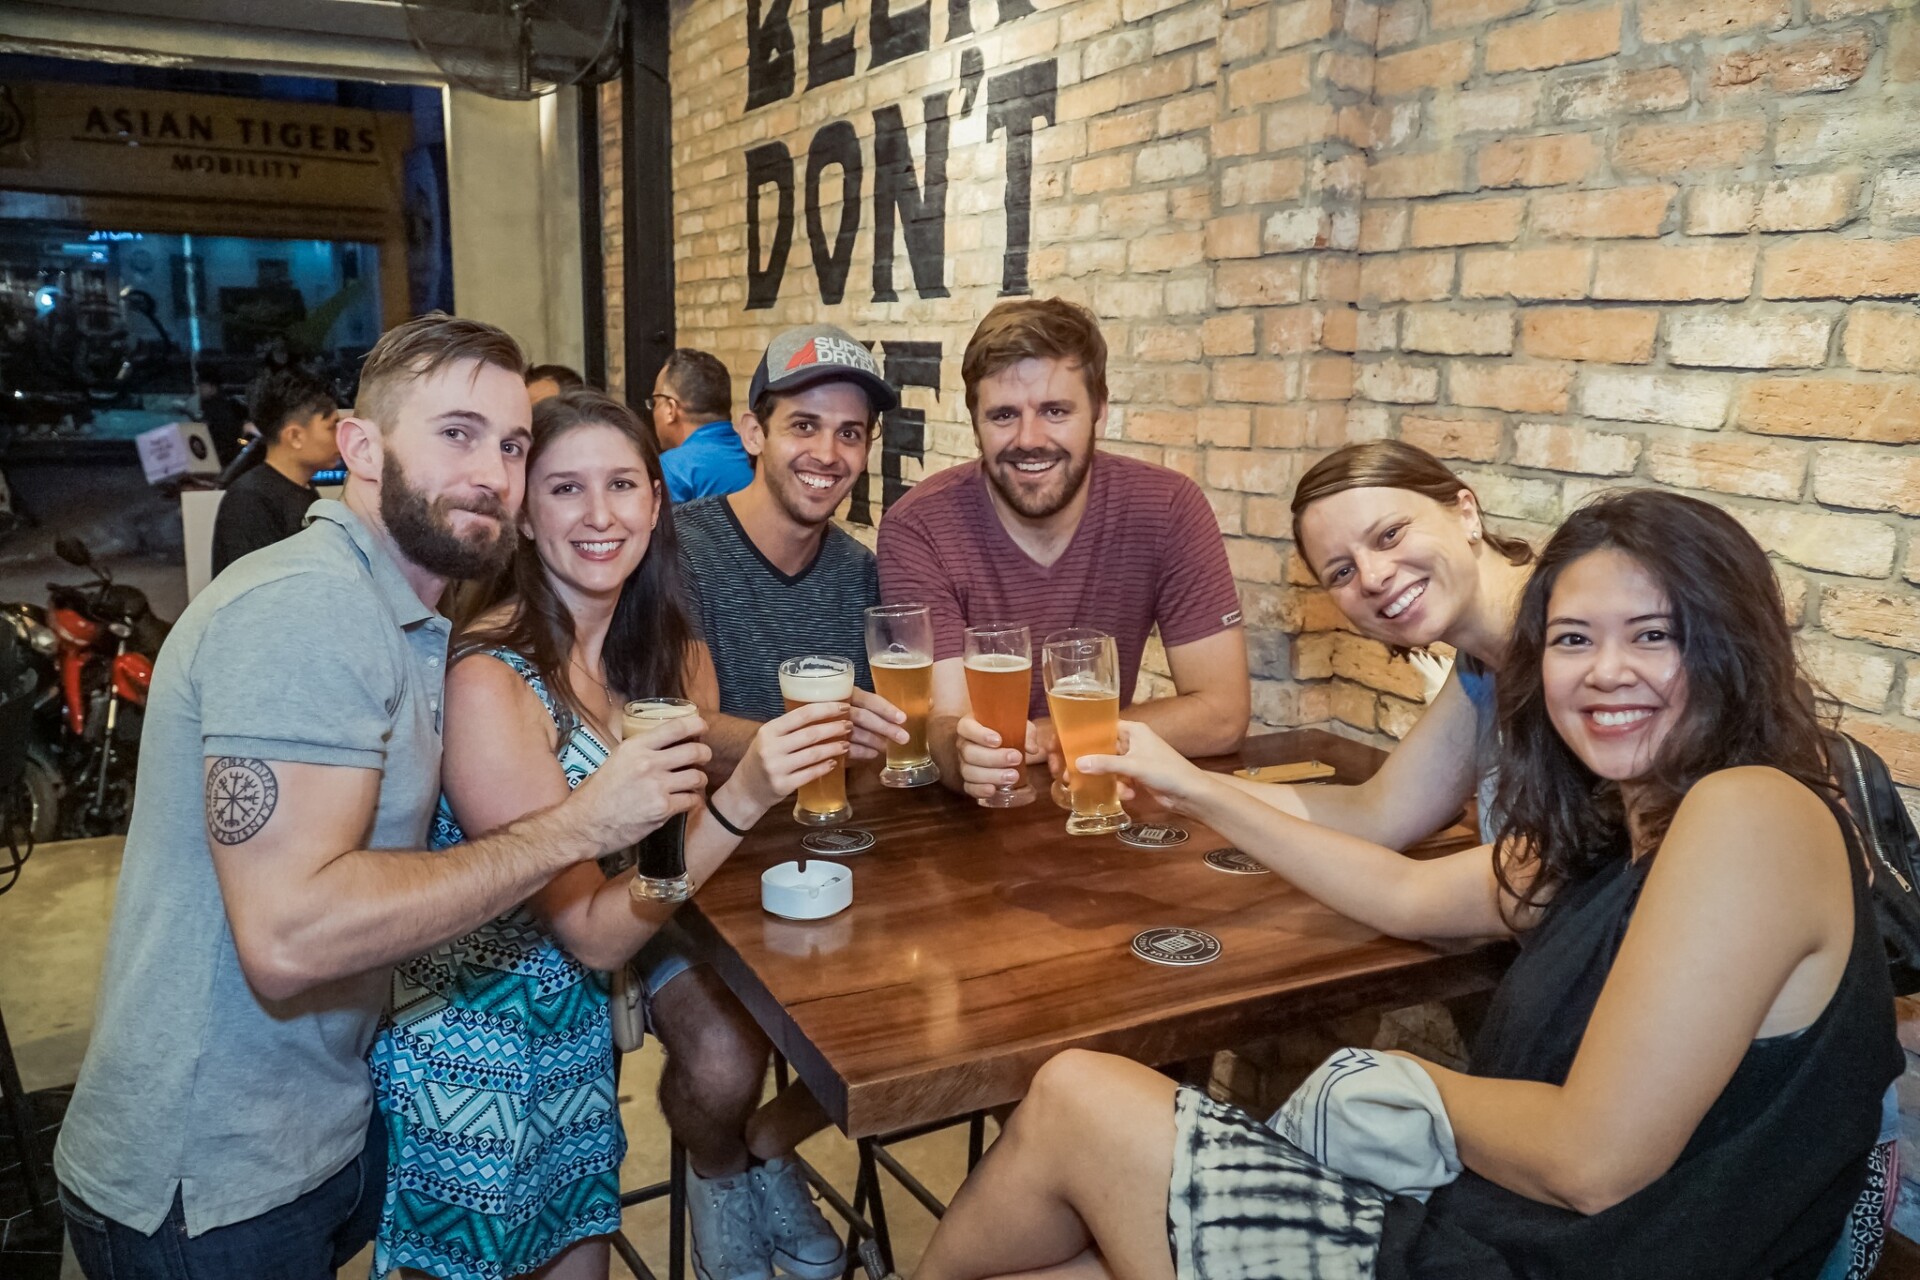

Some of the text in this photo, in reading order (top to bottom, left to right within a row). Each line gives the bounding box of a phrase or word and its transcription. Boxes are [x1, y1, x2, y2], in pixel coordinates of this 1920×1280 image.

[86, 107, 377, 154] ASIAN TIGERS
[171, 154, 301, 180] MOBILITY
[744, 46, 1058, 311] DON'T
